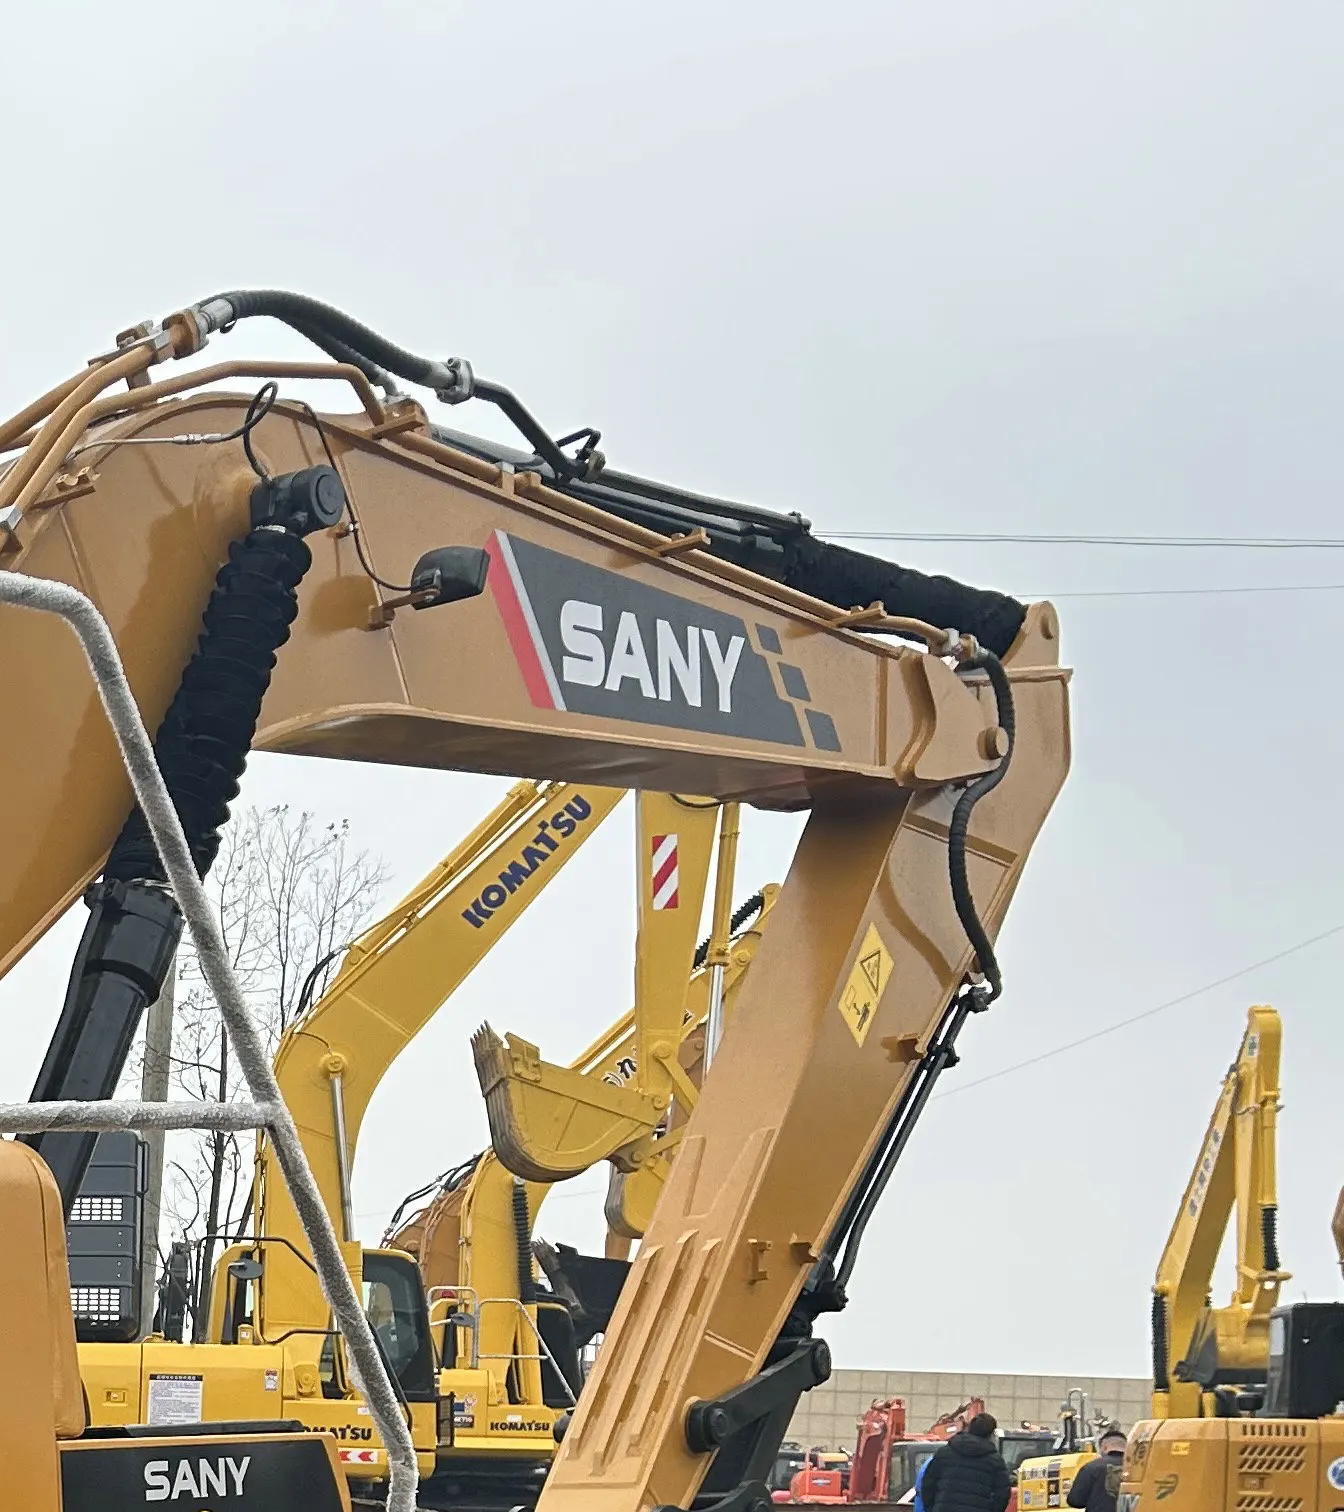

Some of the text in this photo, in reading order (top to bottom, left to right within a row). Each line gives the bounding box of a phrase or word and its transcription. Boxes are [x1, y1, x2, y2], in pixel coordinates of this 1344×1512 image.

[560, 599, 748, 713] SANY
[461, 794, 593, 930] KOMATSU
[490, 1420, 550, 1431] KOMATSU
[144, 1456, 252, 1502] SANY
